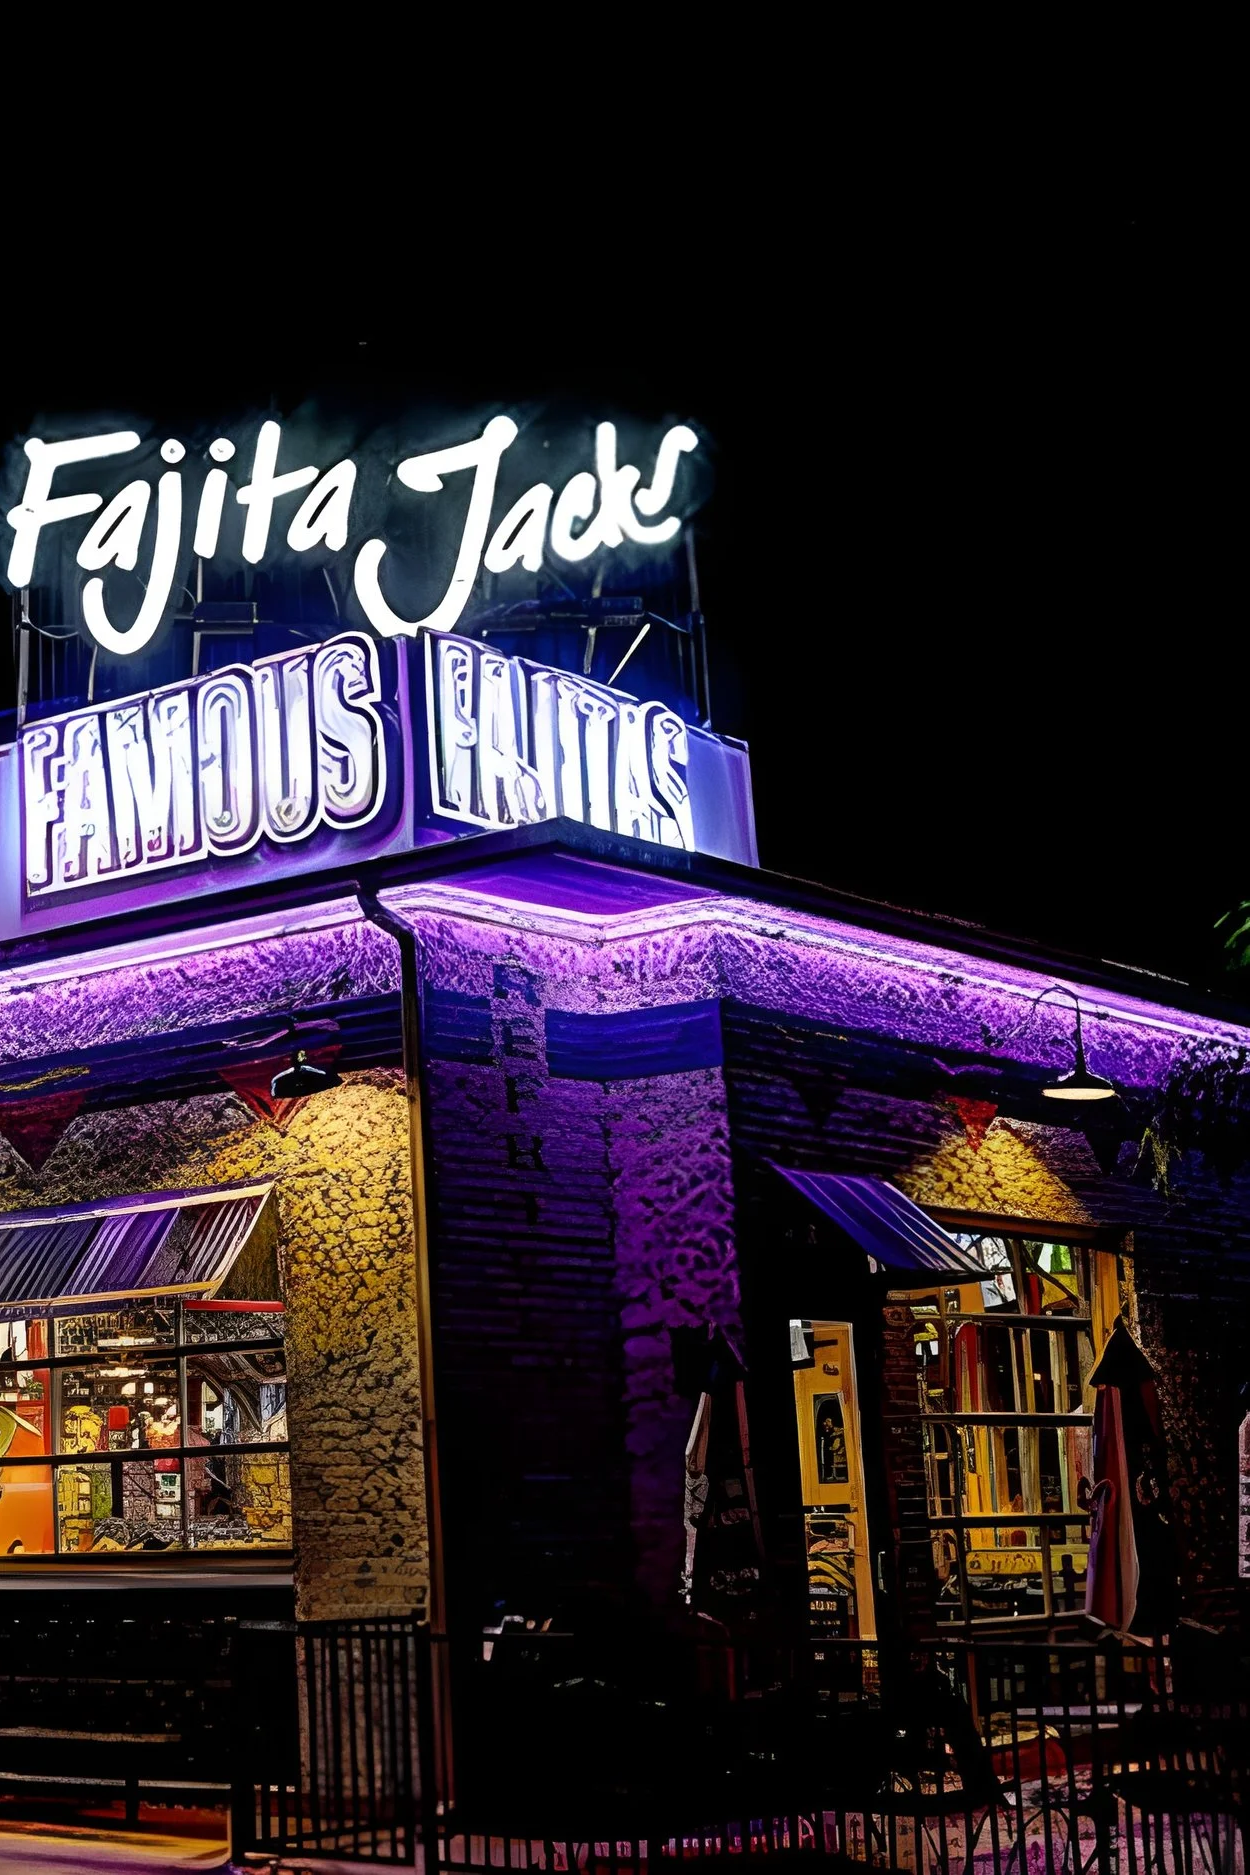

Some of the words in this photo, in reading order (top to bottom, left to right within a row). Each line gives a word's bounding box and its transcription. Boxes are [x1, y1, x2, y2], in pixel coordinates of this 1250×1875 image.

[6, 421, 356, 655] Fajita
[354, 415, 698, 638] Jacks
[22, 637, 380, 889] FAMOUS
